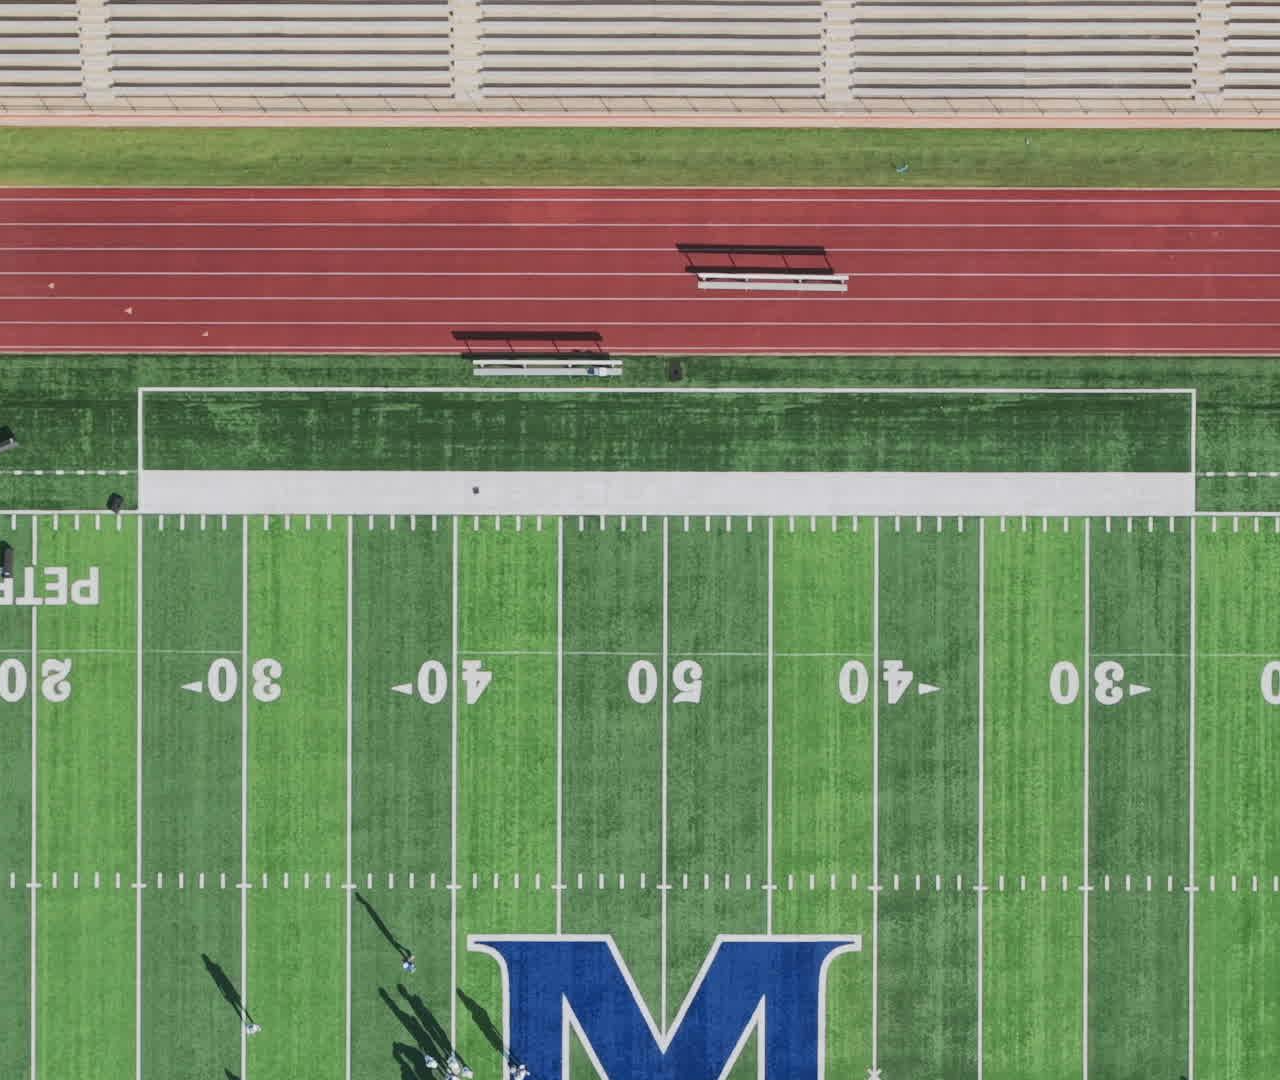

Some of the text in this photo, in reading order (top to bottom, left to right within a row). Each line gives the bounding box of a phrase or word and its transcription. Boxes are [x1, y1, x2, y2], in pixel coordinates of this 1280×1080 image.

[206, 657, 282, 702] 30
[417, 658, 492, 702] 40
[627, 658, 703, 704] 50
[838, 659, 914, 704] 40
[1049, 660, 1124, 704] 30
